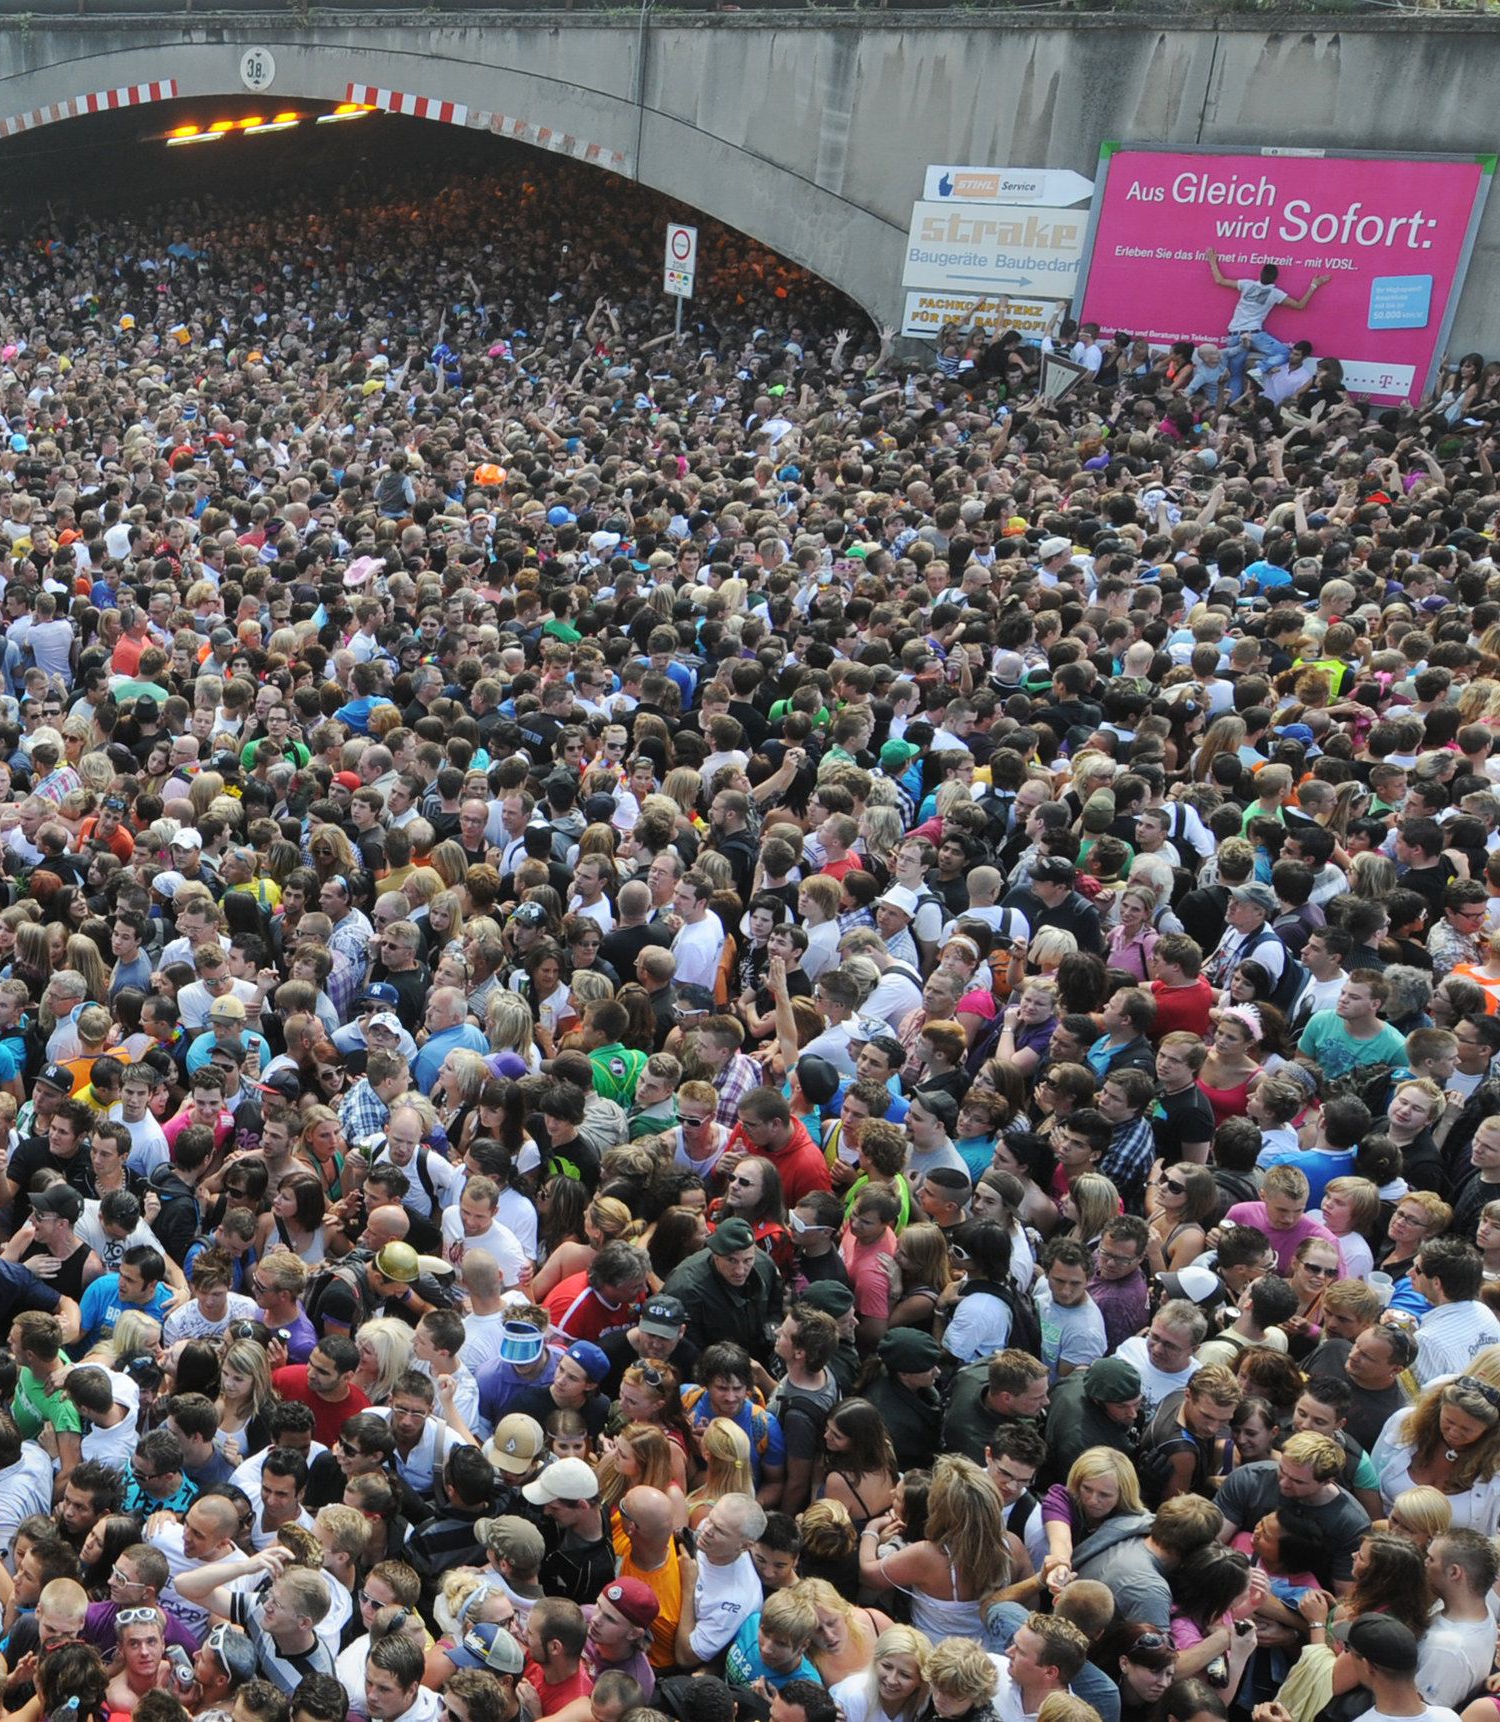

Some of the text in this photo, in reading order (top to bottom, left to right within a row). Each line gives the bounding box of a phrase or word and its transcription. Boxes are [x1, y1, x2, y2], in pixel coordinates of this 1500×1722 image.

[956, 179, 1036, 193] STIHL Service
[1126, 171, 1277, 207] Aus Gleich
[920, 212, 1079, 250] strake
[1215, 199, 1438, 249] wird Sofort:
[909, 248, 1082, 273] Baugeräte Baubedarf
[1114, 245, 1154, 258] Erleben
[1155, 247, 1173, 259] Sie
[1174, 249, 1193, 260] das
[1194, 249, 1236, 263] Innet
[1237, 252, 1248, 263] in
[1250, 252, 1293, 266] Echtzeit
[1304, 257, 1322, 268] mit
[911, 310, 940, 323] FÜR
[942, 313, 970, 325] DE
[1380, 374, 1393, 388] T
